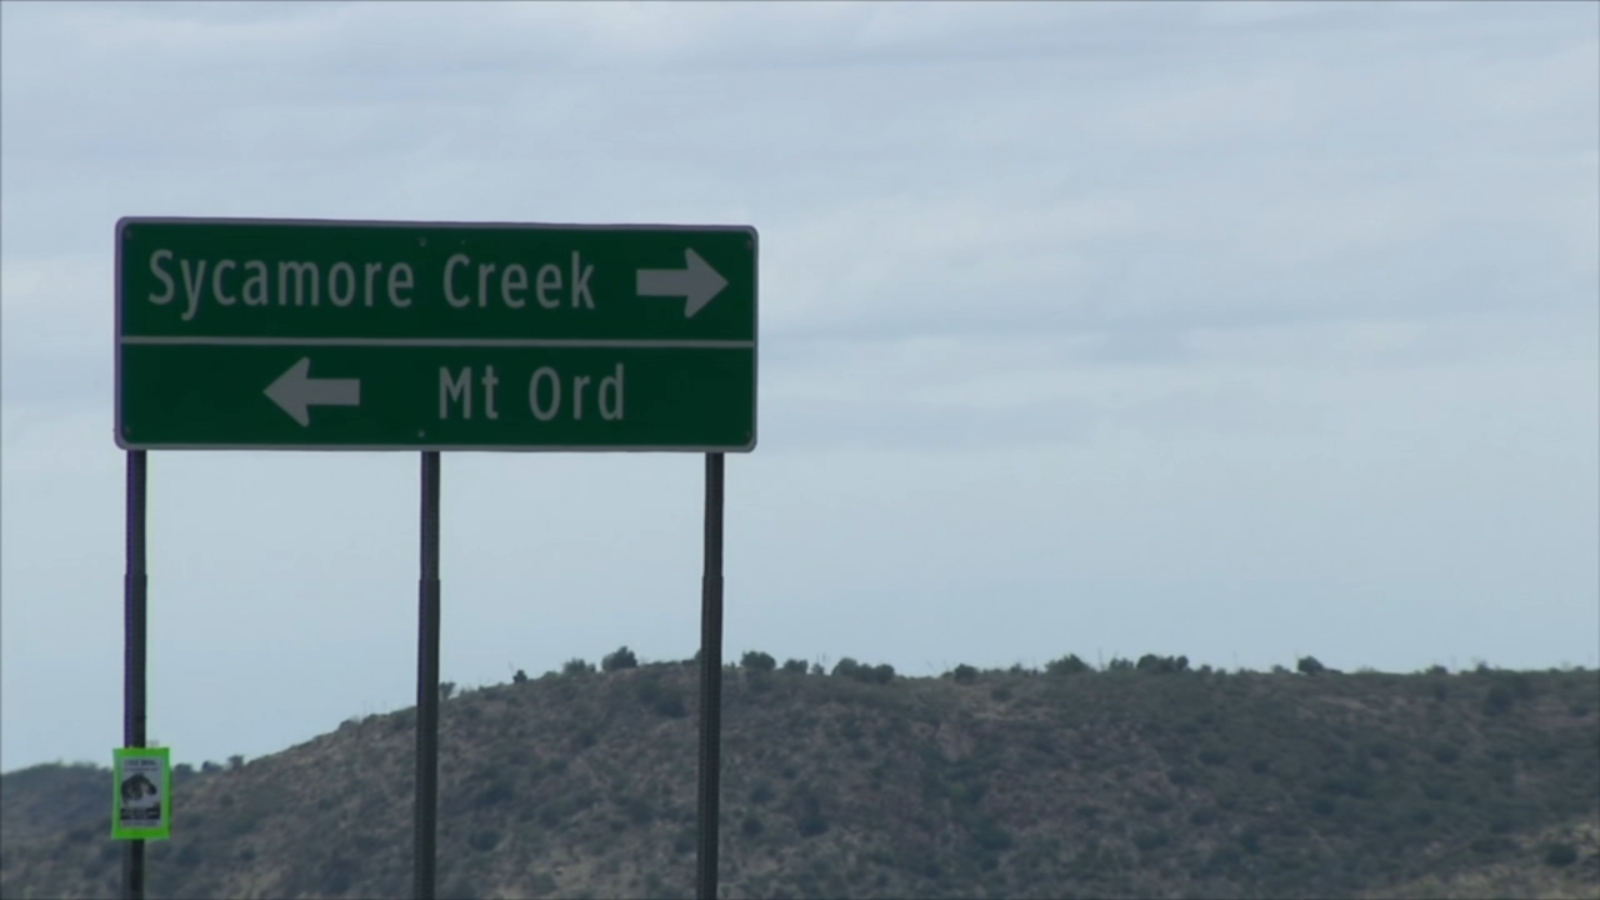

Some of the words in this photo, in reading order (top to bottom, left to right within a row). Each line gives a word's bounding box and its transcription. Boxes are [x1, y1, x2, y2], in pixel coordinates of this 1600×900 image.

[148, 249, 414, 320] Sycamore
[443, 251, 596, 309] Creek
[438, 366, 499, 420] Mt
[528, 363, 625, 421] Ord
